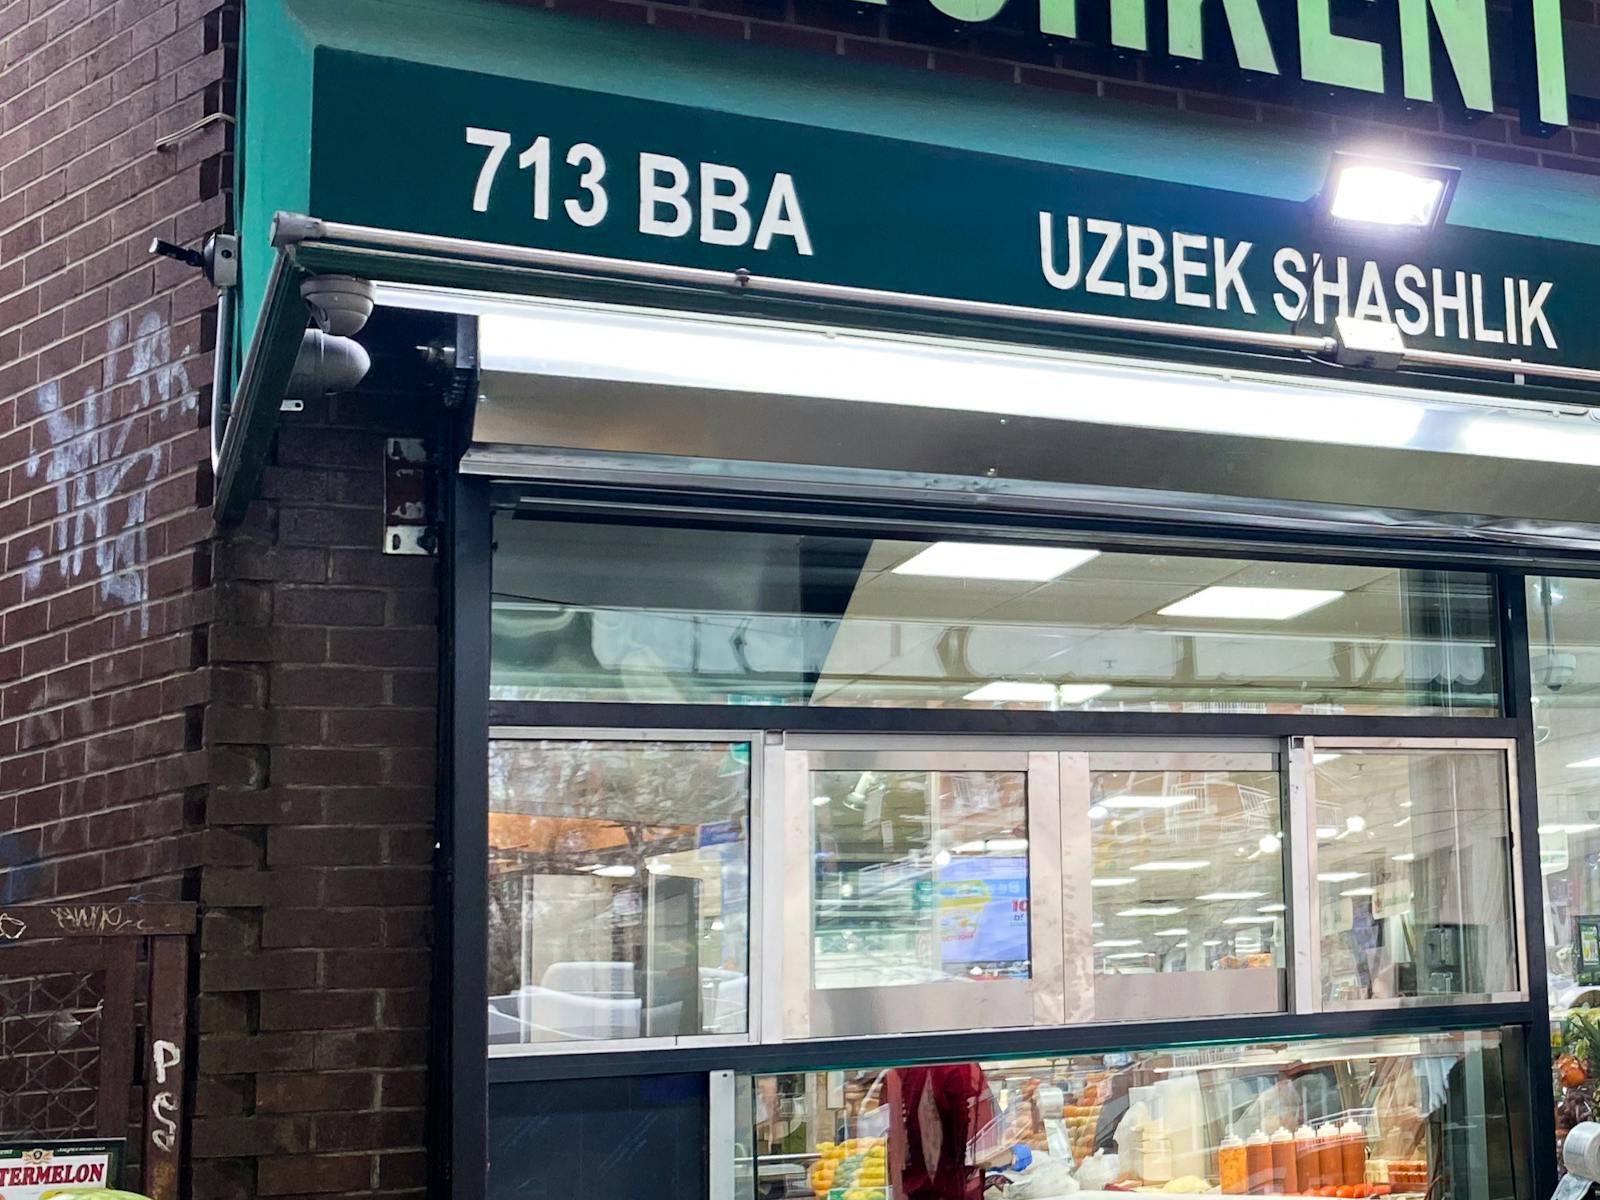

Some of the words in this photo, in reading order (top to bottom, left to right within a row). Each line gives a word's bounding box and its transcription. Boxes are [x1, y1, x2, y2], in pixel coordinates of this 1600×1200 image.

[465, 126, 609, 227] 713
[639, 152, 814, 256] BBA
[1039, 211, 1257, 315] UZBEK
[1272, 247, 1558, 349] SHASHLIK
